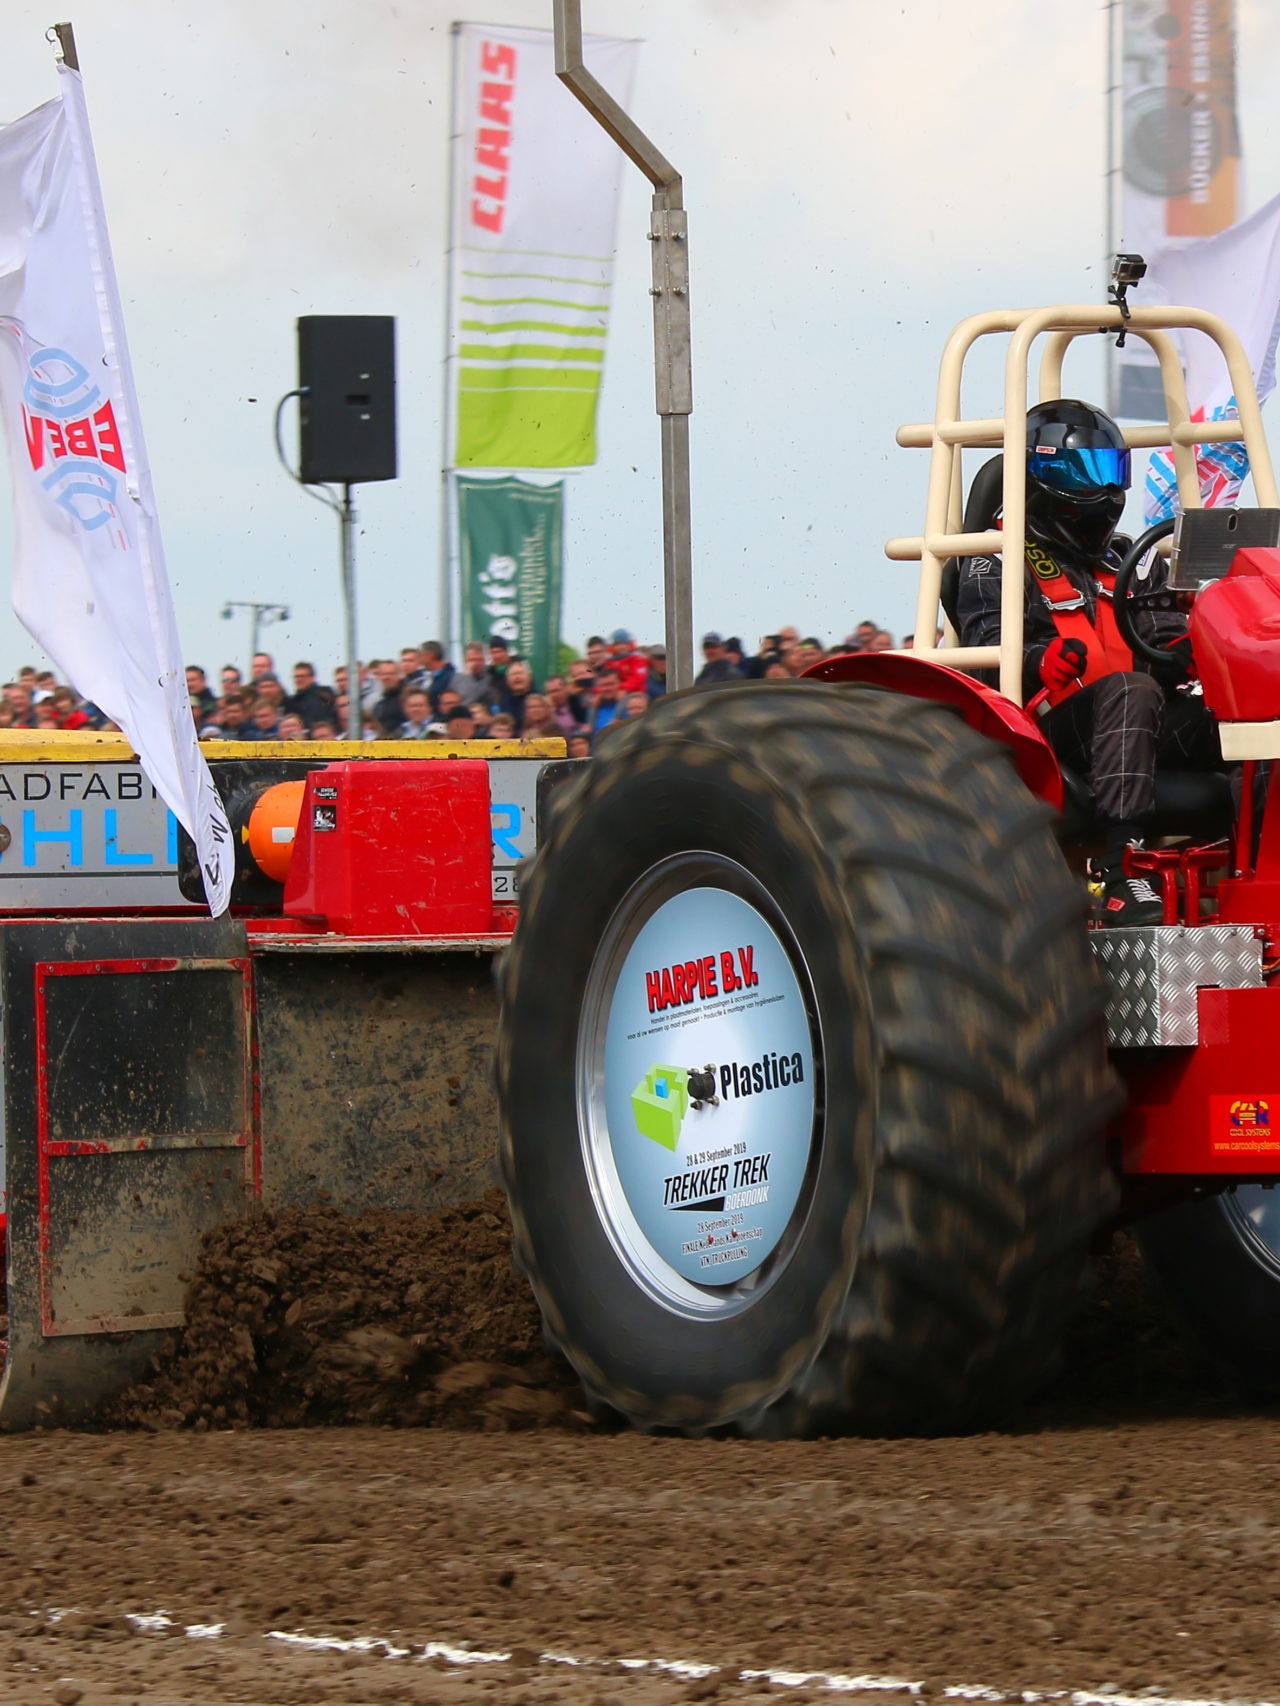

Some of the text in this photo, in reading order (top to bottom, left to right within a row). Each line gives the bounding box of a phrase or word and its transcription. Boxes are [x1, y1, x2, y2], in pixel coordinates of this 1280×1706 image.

[471, 41, 518, 234] CLAAS
[645, 945, 759, 1012] HARPIE B.V.
[648, 1025, 663, 1034] wensen
[704, 1010, 723, 1020] Productie
[727, 1004, 746, 1016] montage
[720, 1052, 804, 1100] Plastica
[1245, 1128, 1271, 1136] SYSTEMS
[686, 1155, 693, 1166] 28
[699, 1151, 705, 1163] 29
[706, 1145, 733, 1163] September
[733, 1142, 747, 1155] 2019
[664, 1154, 770, 1205] TREKKER TREK
[725, 1186, 769, 1211] BOERDONK
[705, 1217, 731, 1232] September
[731, 1213, 744, 1225] 2019
[711, 1247, 748, 1264] TRUCKPULLING
